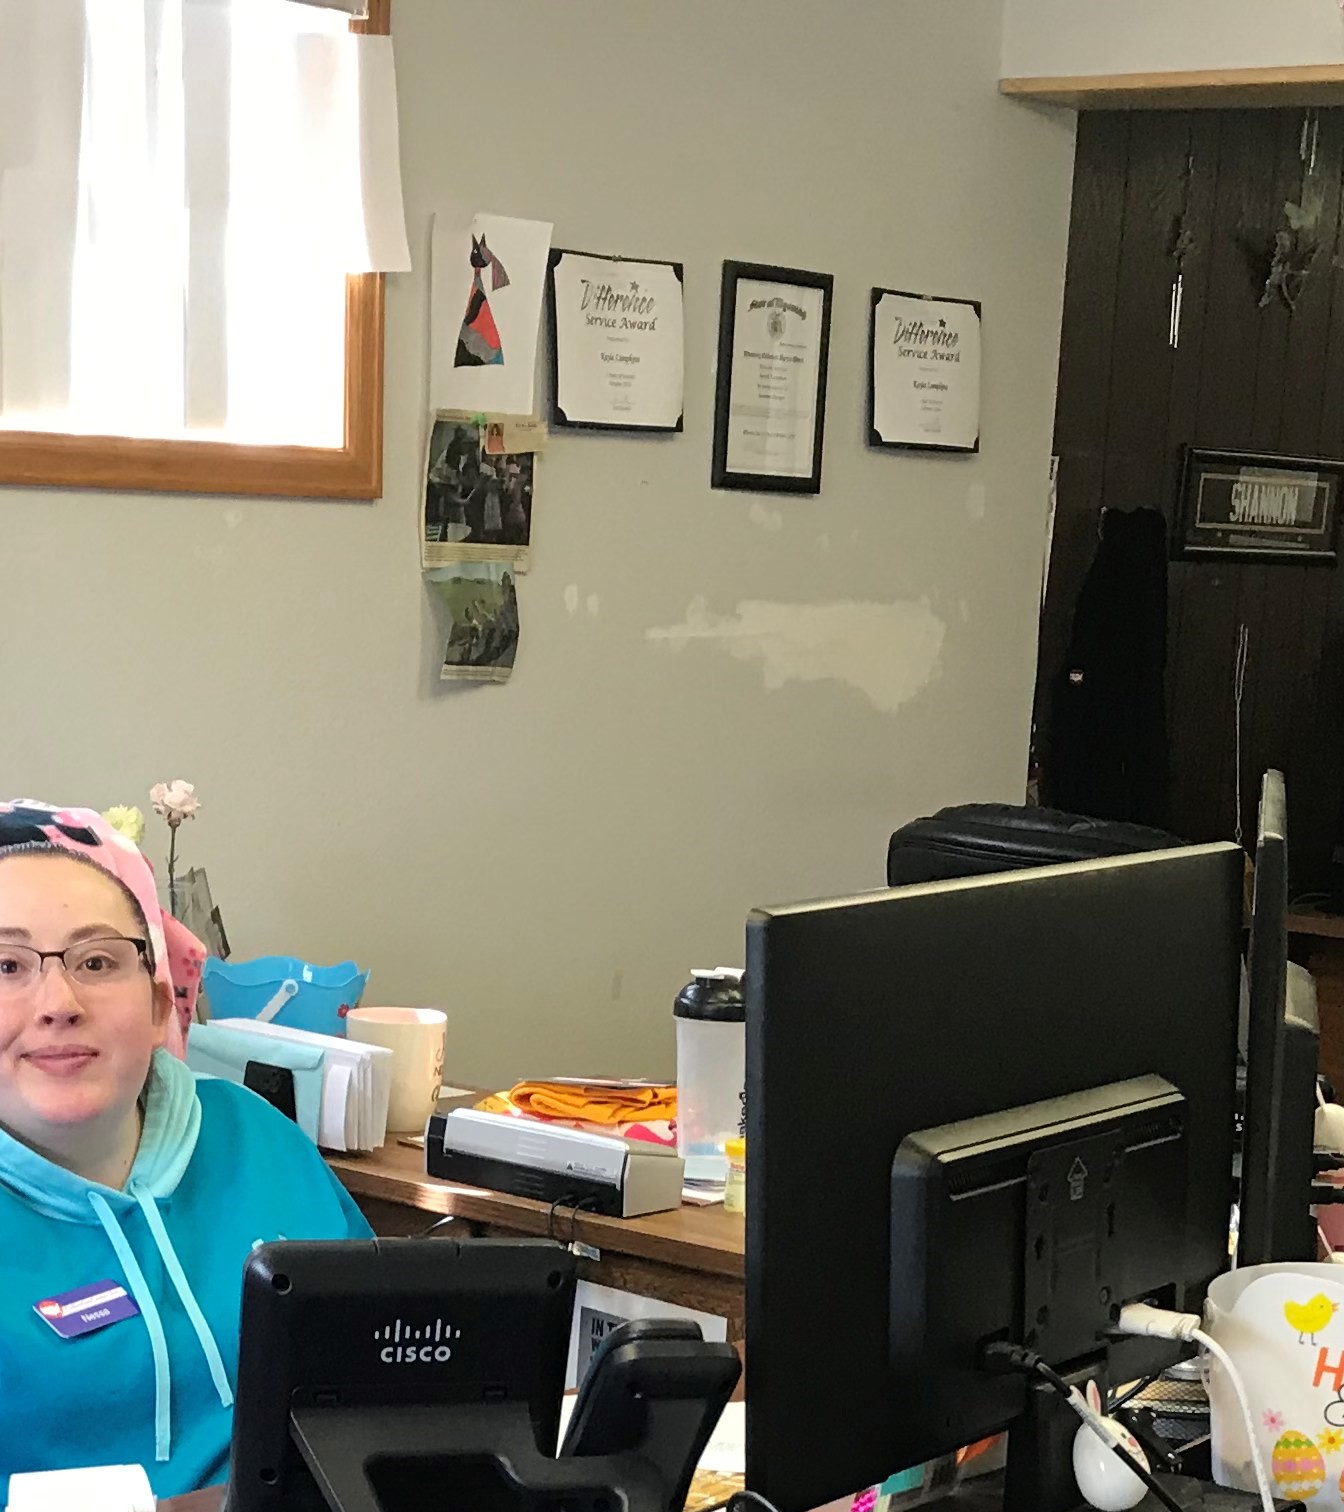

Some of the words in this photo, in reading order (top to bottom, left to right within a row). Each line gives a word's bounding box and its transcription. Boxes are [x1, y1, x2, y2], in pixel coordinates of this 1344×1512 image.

[585, 313, 617, 329] Service
[619, 317, 658, 331] Award
[898, 346, 928, 360] Service
[930, 349, 960, 363] Award
[1229, 482, 1299, 525] SHANNON
[80, 1308, 111, 1323] Nessa
